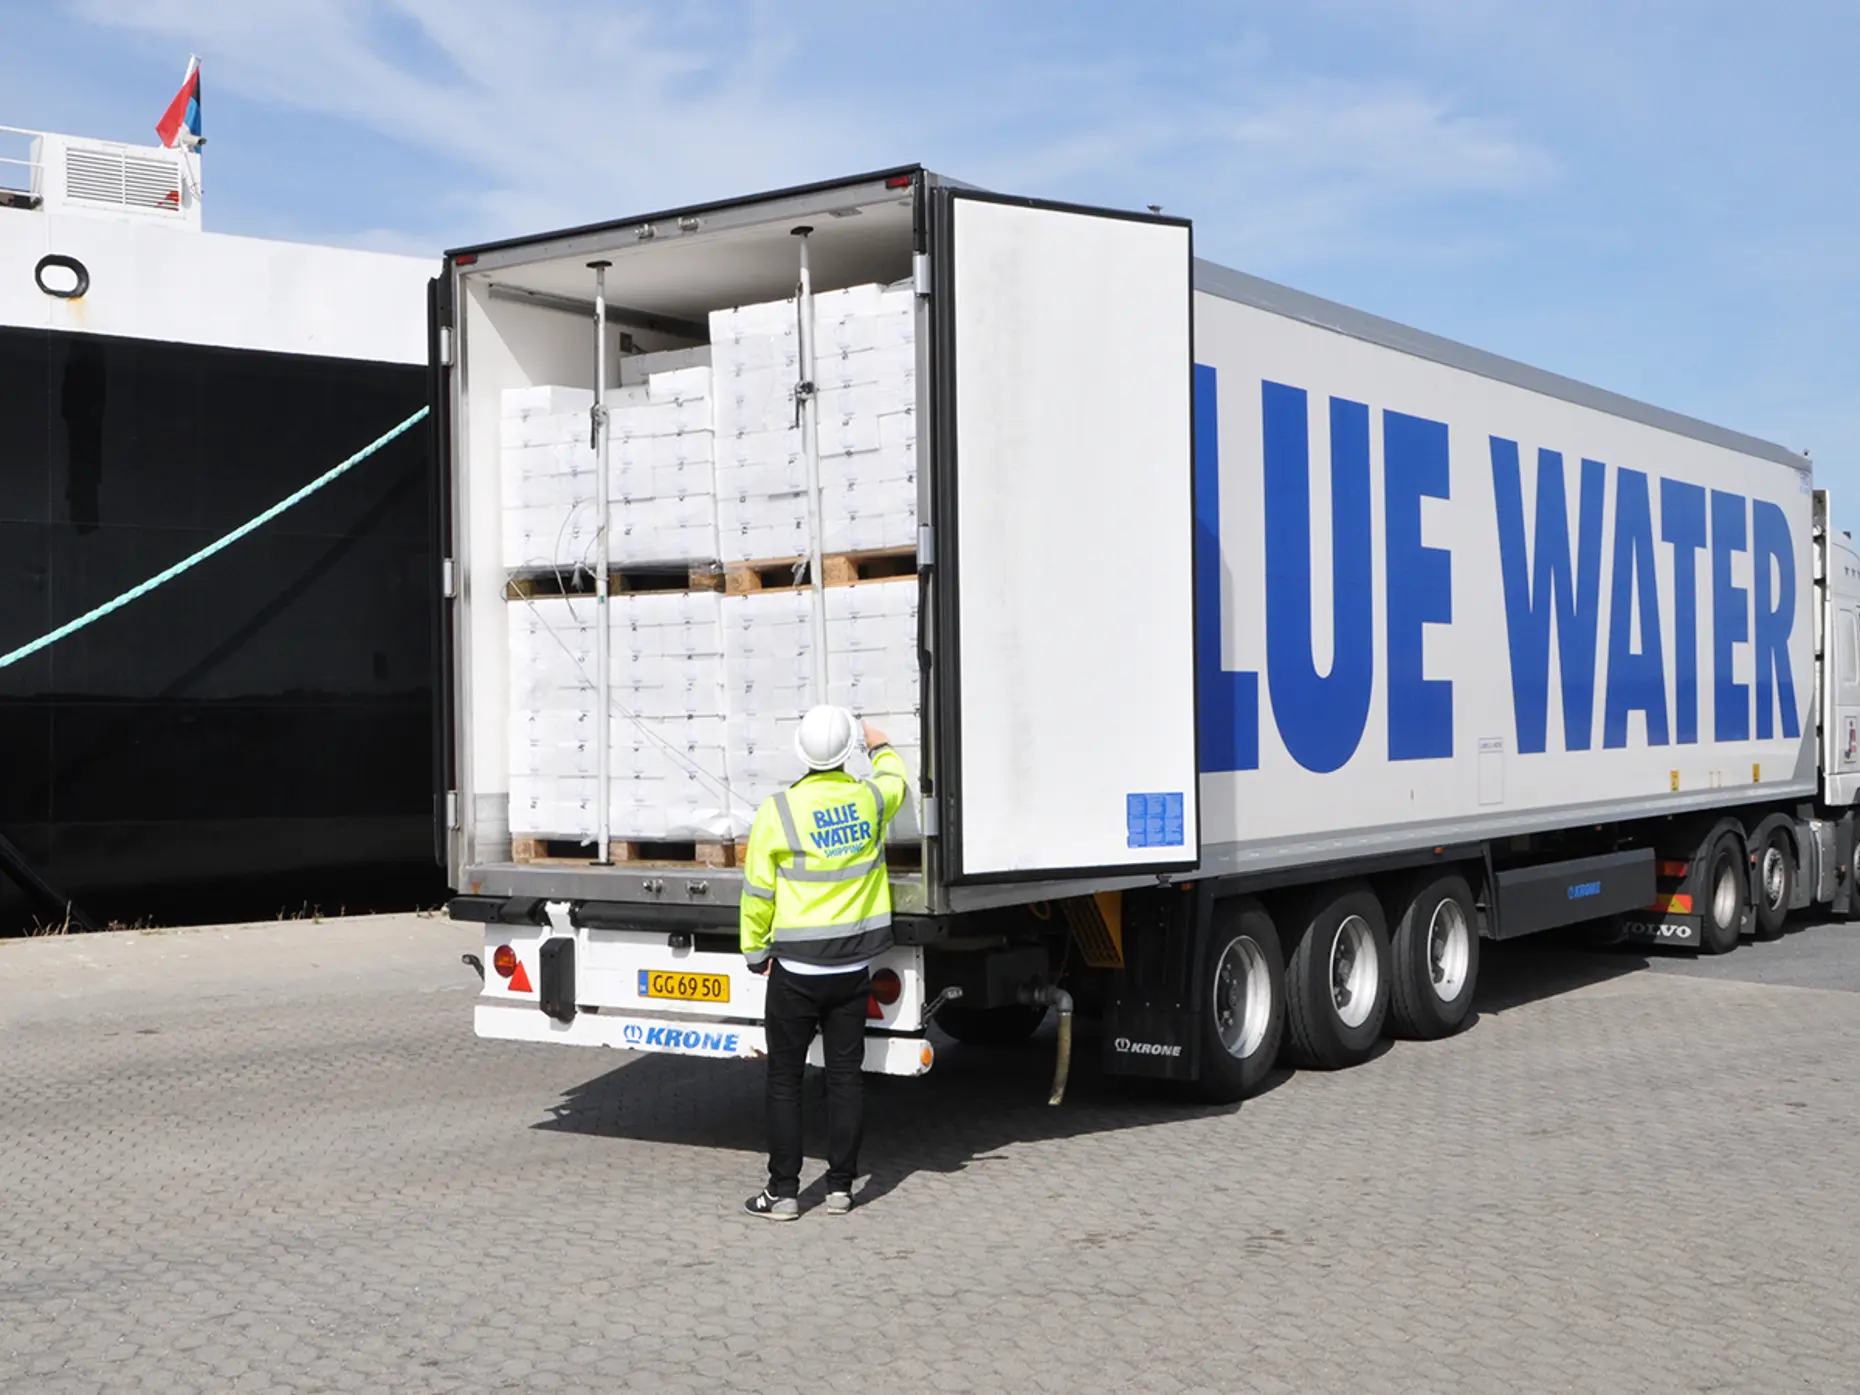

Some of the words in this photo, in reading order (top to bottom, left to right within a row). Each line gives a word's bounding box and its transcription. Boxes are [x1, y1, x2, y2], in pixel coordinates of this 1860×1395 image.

[1194, 363, 1453, 774] LUE
[1489, 434, 1801, 755] WATER
[812, 802, 860, 829] BLUE
[809, 820, 872, 849] WATER
[653, 974, 675, 994] GG
[678, 976, 698, 997] 69
[701, 978, 722, 998] 50
[645, 1027, 741, 1052] KRONE
[1130, 1042, 1182, 1057] KRONE
